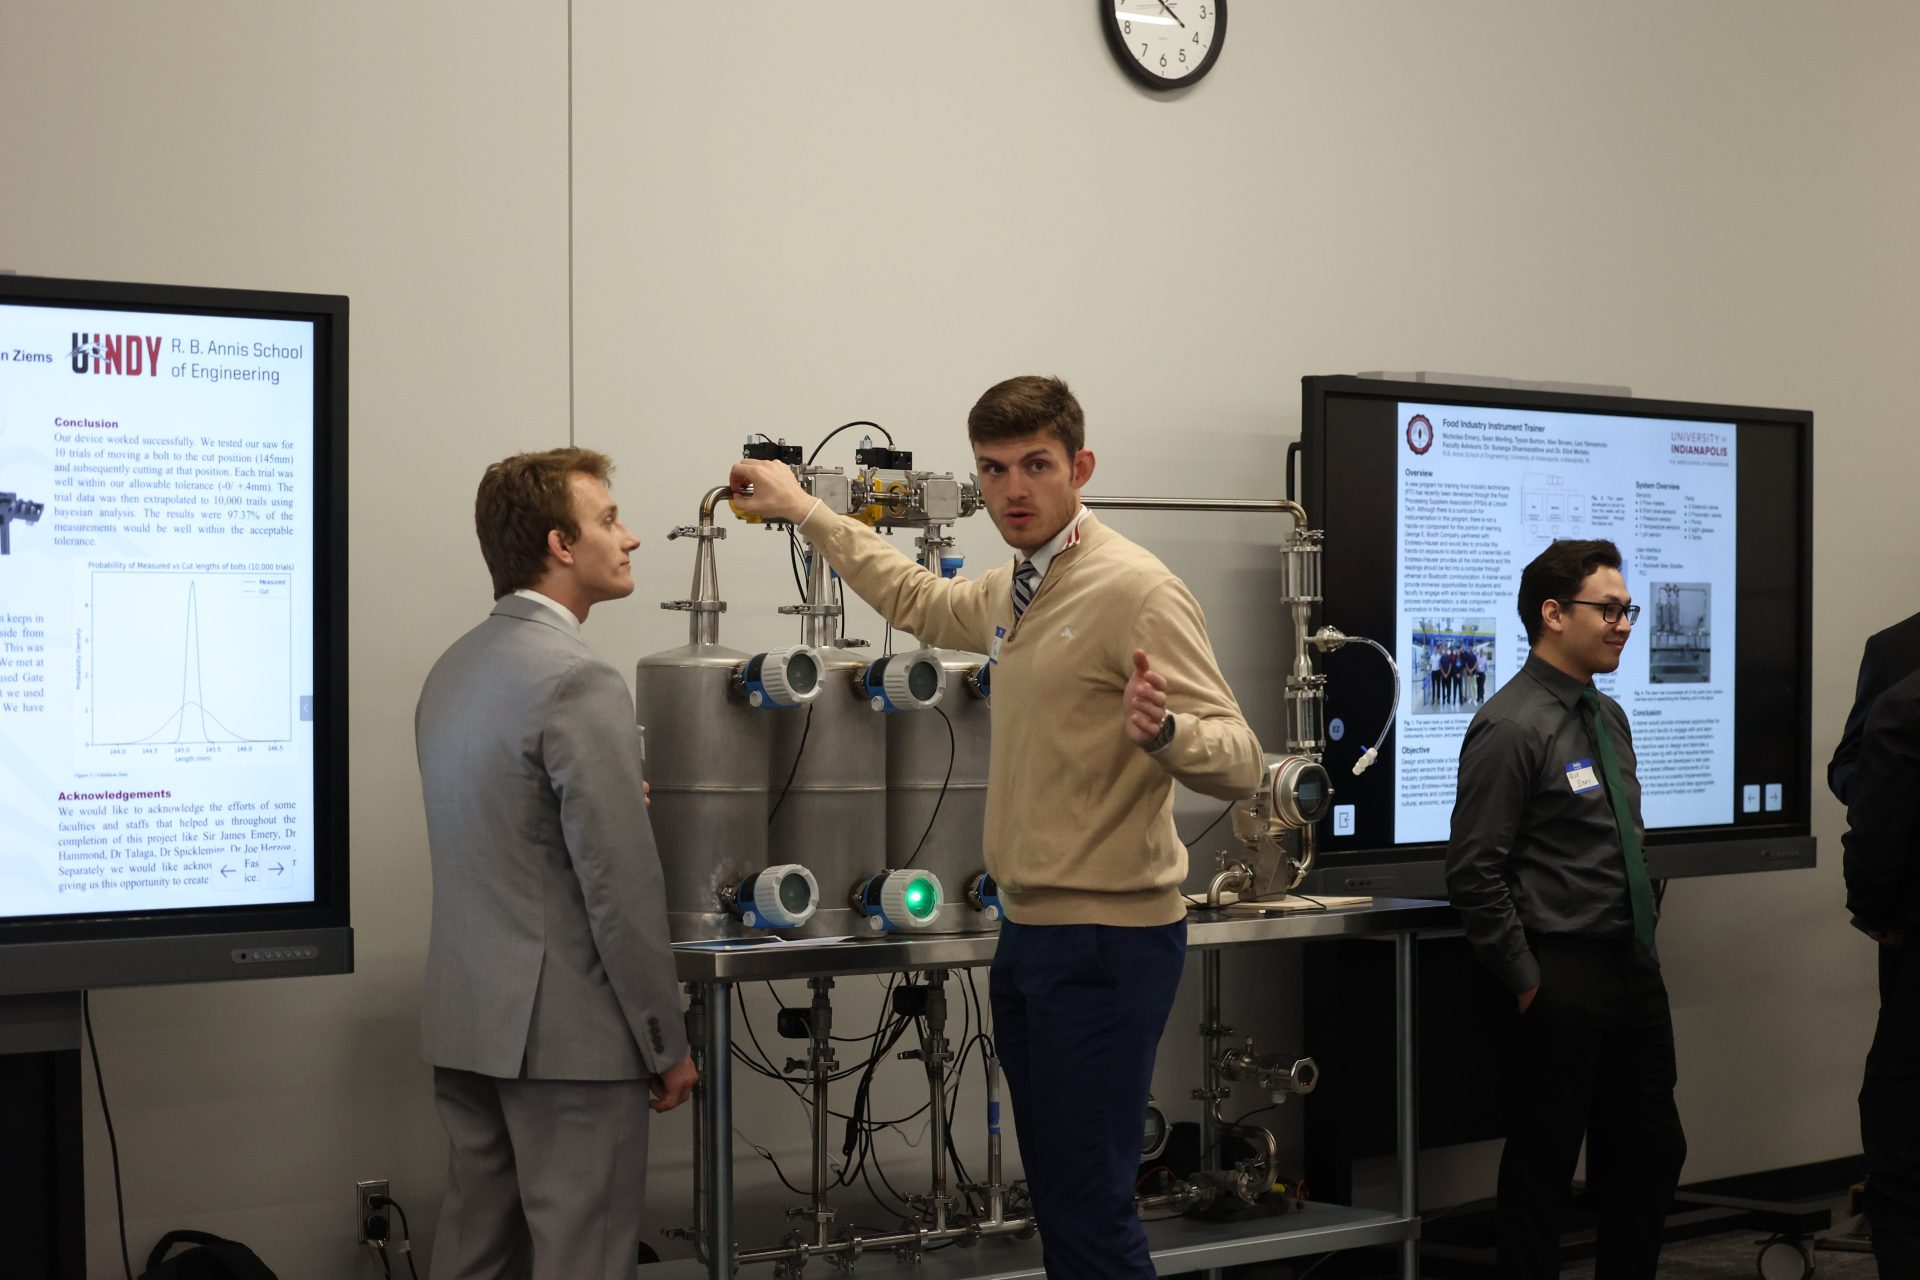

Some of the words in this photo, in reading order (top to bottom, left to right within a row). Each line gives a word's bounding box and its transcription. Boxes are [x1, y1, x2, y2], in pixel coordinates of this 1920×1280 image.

[1200, 6, 1206, 19] 3
[1124, 21, 1131, 34] 8
[1192, 32, 1199, 44] 4
[1142, 44, 1148, 56] 7
[1179, 49, 1186, 62] 5
[1160, 54, 1167, 67] 6
[11, 349, 53, 363] Ziems
[171, 338, 185, 354] R.
[189, 338, 204, 355] B.
[207, 340, 249, 356] Annis
[252, 342, 303, 359] School
[171, 362, 186, 378] of
[191, 363, 280, 385] Engineering
[54, 418, 119, 429] Conclusion
[1442, 418, 1459, 428] Food
[1460, 420, 1487, 431] Industry
[1487, 421, 1523, 432] Instrument
[1523, 423, 1546, 433] Trainer
[54, 432, 70, 443] Our
[74, 433, 103, 444] device
[107, 434, 139, 445] worked
[200, 436, 214, 447] We
[218, 437, 242, 448] tested
[262, 441, 278, 449] saw
[281, 439, 293, 450] for
[55, 447, 66, 458] 10
[69, 447, 91, 458] trials
[94, 448, 104, 458] of
[107, 449, 141, 462] moving
[143, 452, 149, 460] a
[152, 450, 170, 460] bolt
[173, 452, 182, 461] to
[185, 451, 198, 462] the
[201, 453, 215, 462] cut
[217, 452, 252, 465] position
[1671, 444, 1728, 456] INDIANAPOLIS
[54, 462, 70, 476] and
[73, 462, 129, 476] subsequently
[132, 464, 162, 477] cutting
[165, 466, 174, 475] at
[176, 465, 192, 476] that
[234, 466, 256, 477] Each
[258, 467, 274, 478] trial
[277, 470, 294, 478] was
[1405, 468, 1434, 477] Overview
[54, 476, 74, 487] well
[76, 477, 106, 488] within
[128, 478, 171, 489] allowable
[174, 479, 214, 490] tolerance
[277, 481, 294, 494] The
[54, 491, 72, 502] trial
[76, 492, 95, 503] data
[120, 492, 139, 504] then
[143, 494, 196, 507] extrapolated
[200, 496, 209, 504] to
[246, 496, 267, 506] trails
[271, 496, 293, 509] using
[54, 523, 117, 532] measurements
[123, 522, 150, 533] would
[156, 523, 166, 533] be
[173, 524, 191, 534] well
[198, 524, 224, 534] within
[230, 524, 244, 534] the
[249, 525, 294, 538] acceptable
[54, 535, 98, 546] tolerance.
[4, 641, 24, 653] This
[26, 642, 44, 652] was
[6, 690, 20, 698] we
[23, 687, 44, 698] used
[3, 702, 17, 712] We
[23, 702, 43, 712] have
[1402, 746, 1430, 756] Objective
[58, 789, 172, 802] Acknowledgements
[58, 806, 73, 817] We
[79, 805, 106, 816] would
[112, 804, 128, 815] like
[134, 806, 142, 814] to
[148, 802, 204, 816] acknowledge
[209, 801, 222, 812] the
[227, 800, 255, 812] efforts
[260, 800, 269, 810] of
[274, 802, 296, 810] some
[58, 820, 95, 832] faculties
[102, 820, 118, 830] and
[125, 818, 149, 829] staffs
[156, 818, 172, 828] that
[179, 816, 208, 830] helped
[214, 818, 224, 827] us
[231, 814, 276, 828] throughout
[283, 814, 296, 827] the
[58, 835, 107, 848] completion
[112, 834, 121, 845] of
[126, 833, 142, 844] this
[147, 832, 176, 846] project
[182, 831, 198, 842] like
[203, 831, 215, 841] Sir
[220, 829, 246, 845] James
[285, 828, 296, 838] Dr
[58, 864, 104, 878] Separately
[110, 866, 124, 874] we
[128, 862, 156, 873] would
[161, 861, 178, 872] like
[59, 880, 86, 893] giving
[89, 881, 99, 889] us
[101, 878, 117, 889] this
[119, 876, 168, 890] opportunity
[172, 877, 181, 886] to
[183, 876, 208, 885] create
